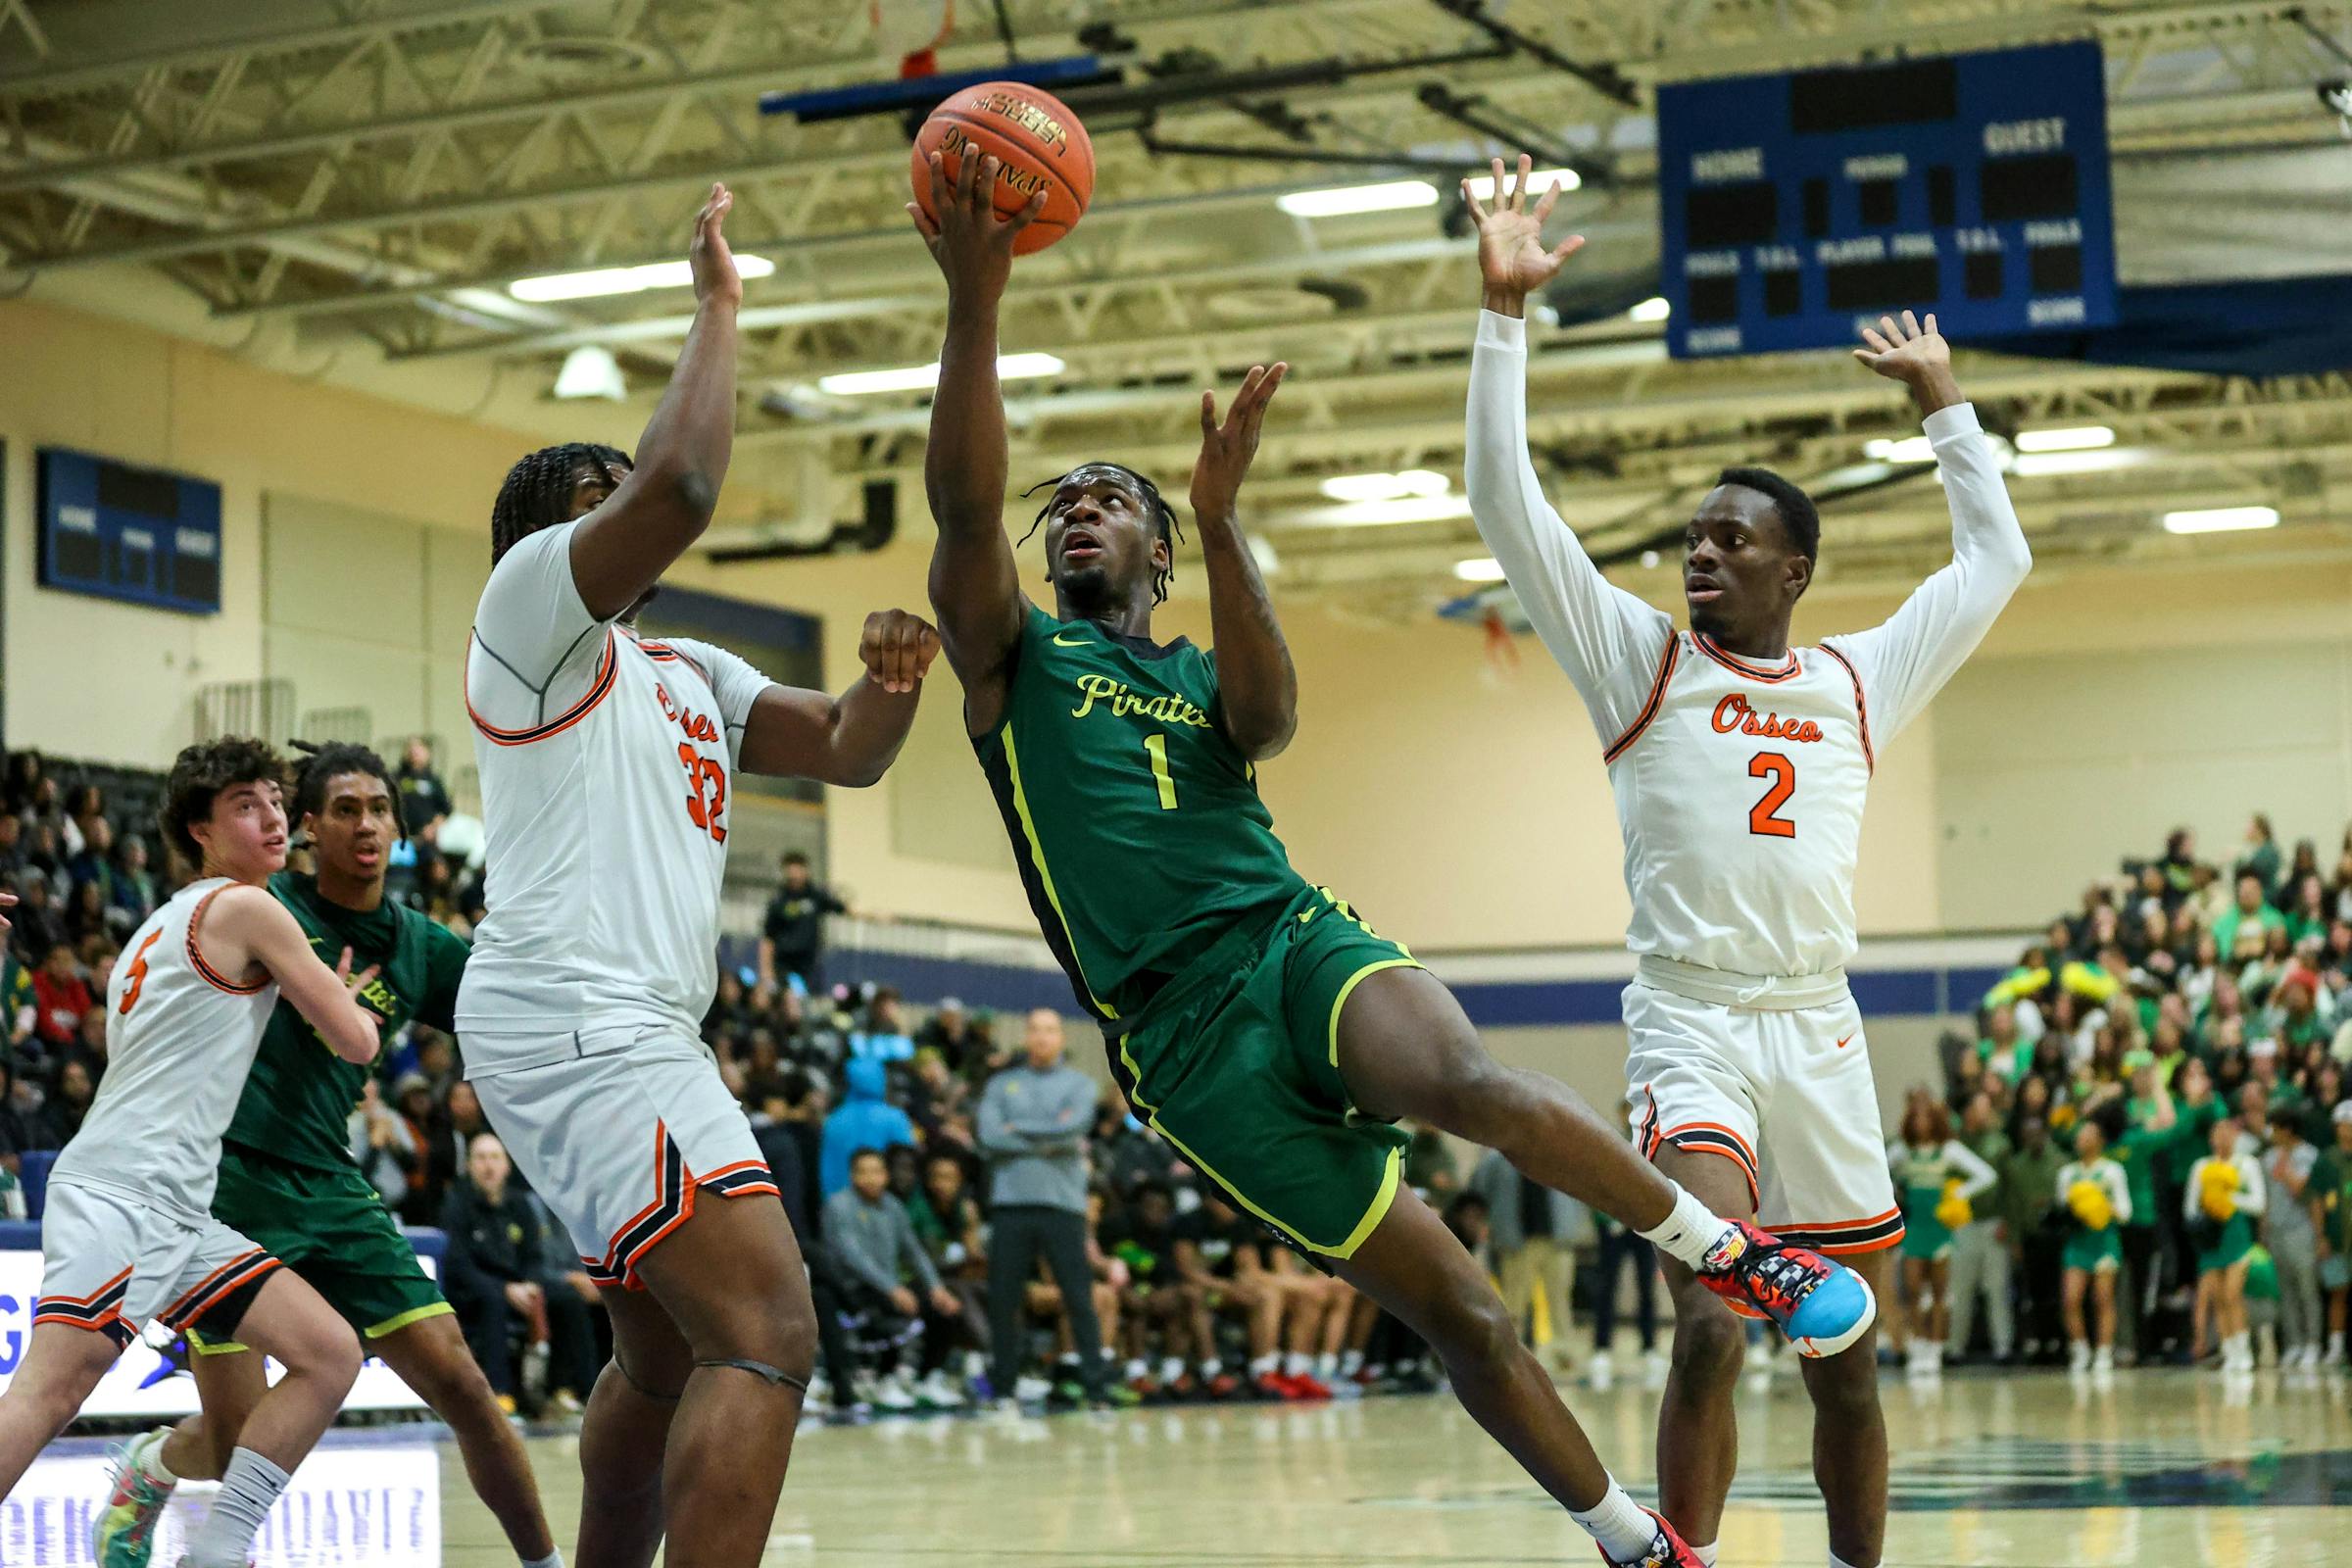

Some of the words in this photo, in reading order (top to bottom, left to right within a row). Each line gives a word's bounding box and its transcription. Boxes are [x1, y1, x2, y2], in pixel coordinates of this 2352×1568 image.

[940, 124, 1053, 196] SPALNG
[1983, 119, 2066, 156] GUEST
[1711, 692, 1824, 743] Osseo
[677, 742, 727, 845] 32
[1143, 732, 1178, 810] 1
[1748, 751, 1796, 839] 2
[118, 925, 164, 1015] 5
